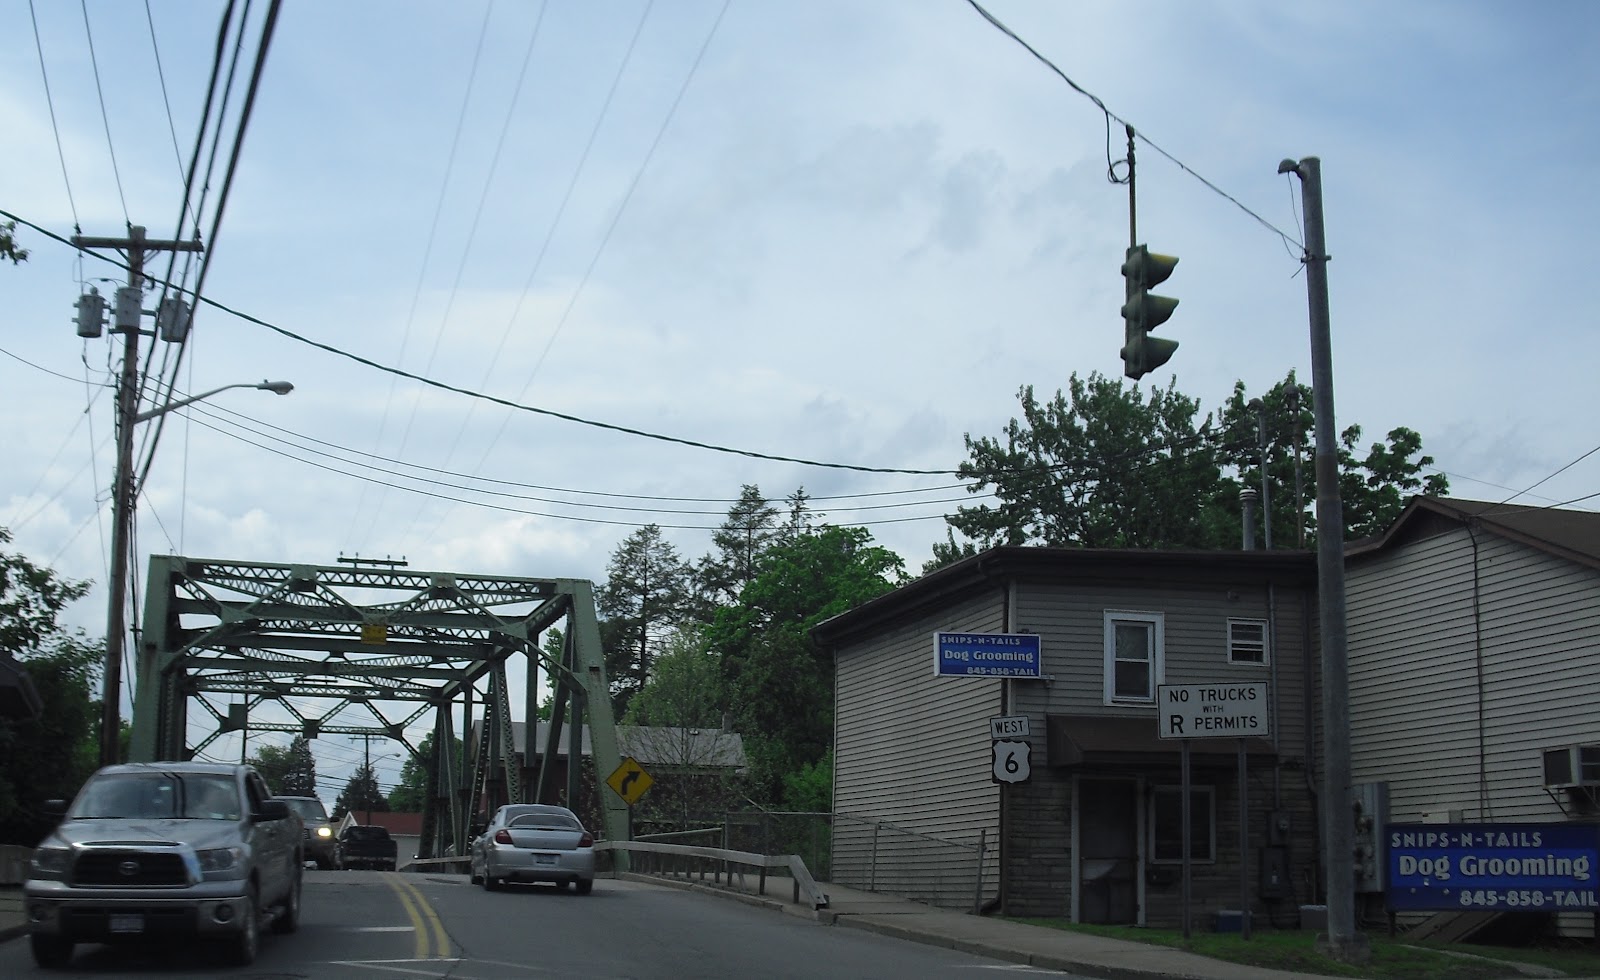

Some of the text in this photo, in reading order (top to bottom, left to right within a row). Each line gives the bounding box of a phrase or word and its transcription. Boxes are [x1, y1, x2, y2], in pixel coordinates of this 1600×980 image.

[942, 636, 1020, 645] SNIPS-N-TAILS
[944, 650, 1033, 663] Dog Grooming
[967, 666, 1035, 676] 845-858-TAIL
[1170, 688, 1256, 702] NO TRUCKS
[1203, 705, 1224, 713] WITH
[995, 721, 1023, 733] WEST
[1170, 715, 1258, 734] R PERMITS
[1005, 751, 1019, 774] 6
[1391, 832, 1543, 848] SNIPS-N-TAILS
[1400, 854, 1590, 881] Dog Grooming
[1460, 890, 1599, 906] 845-858-TAIL
